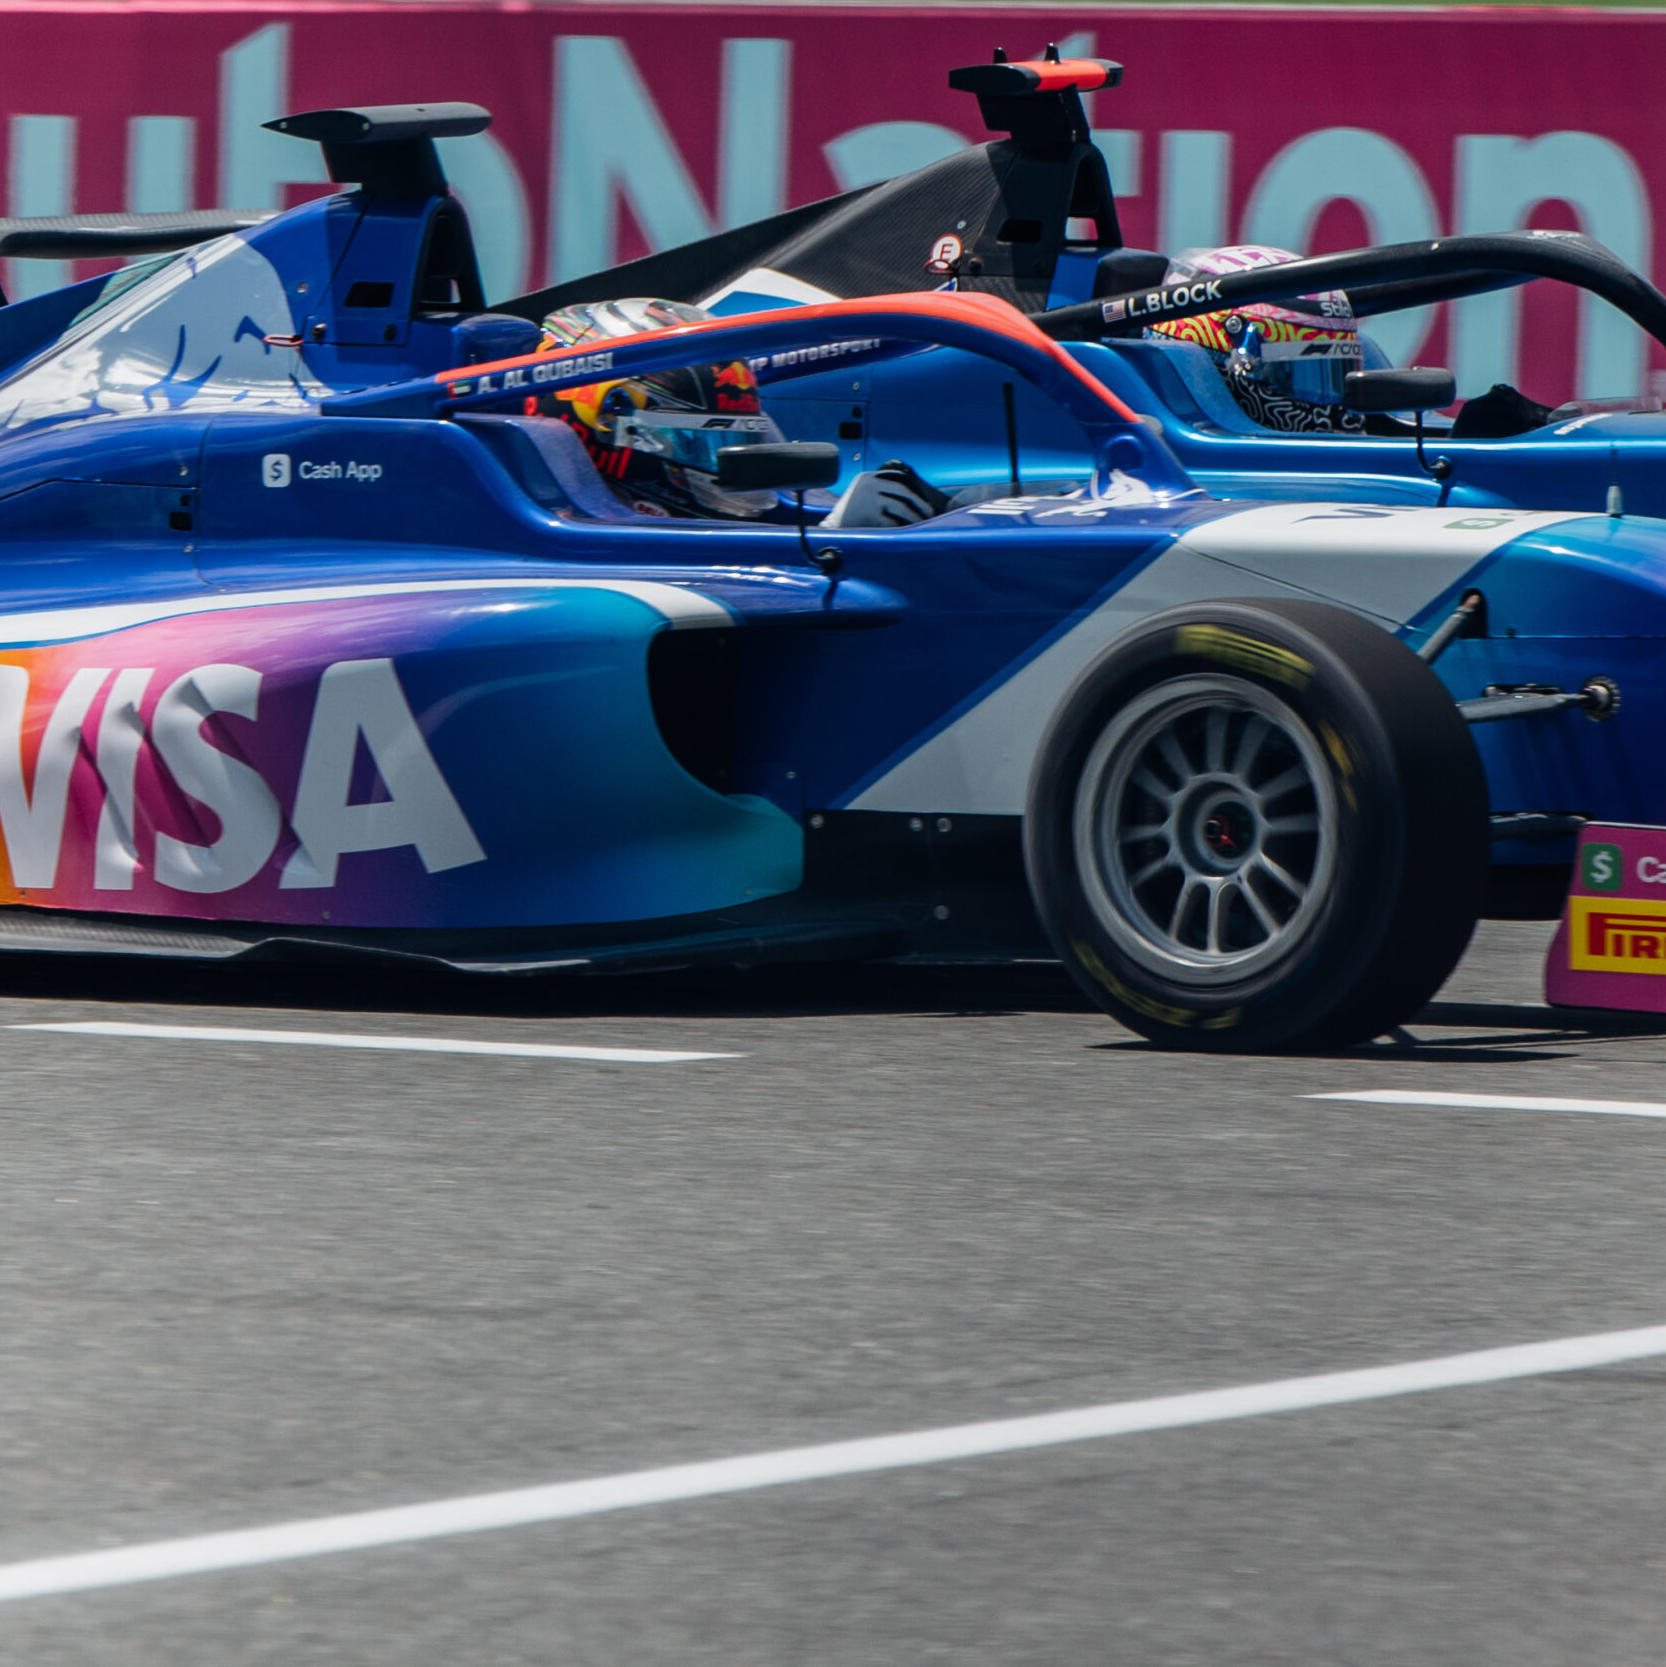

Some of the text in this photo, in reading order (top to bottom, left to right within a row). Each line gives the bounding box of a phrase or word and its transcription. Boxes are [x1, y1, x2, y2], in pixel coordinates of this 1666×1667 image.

[1127, 279, 1223, 318] L.BLOCK
[770, 337, 881, 369] MOTORSPORT
[477, 351, 614, 395] A. AL QUBAISI
[298, 460, 383, 483] Cash App
